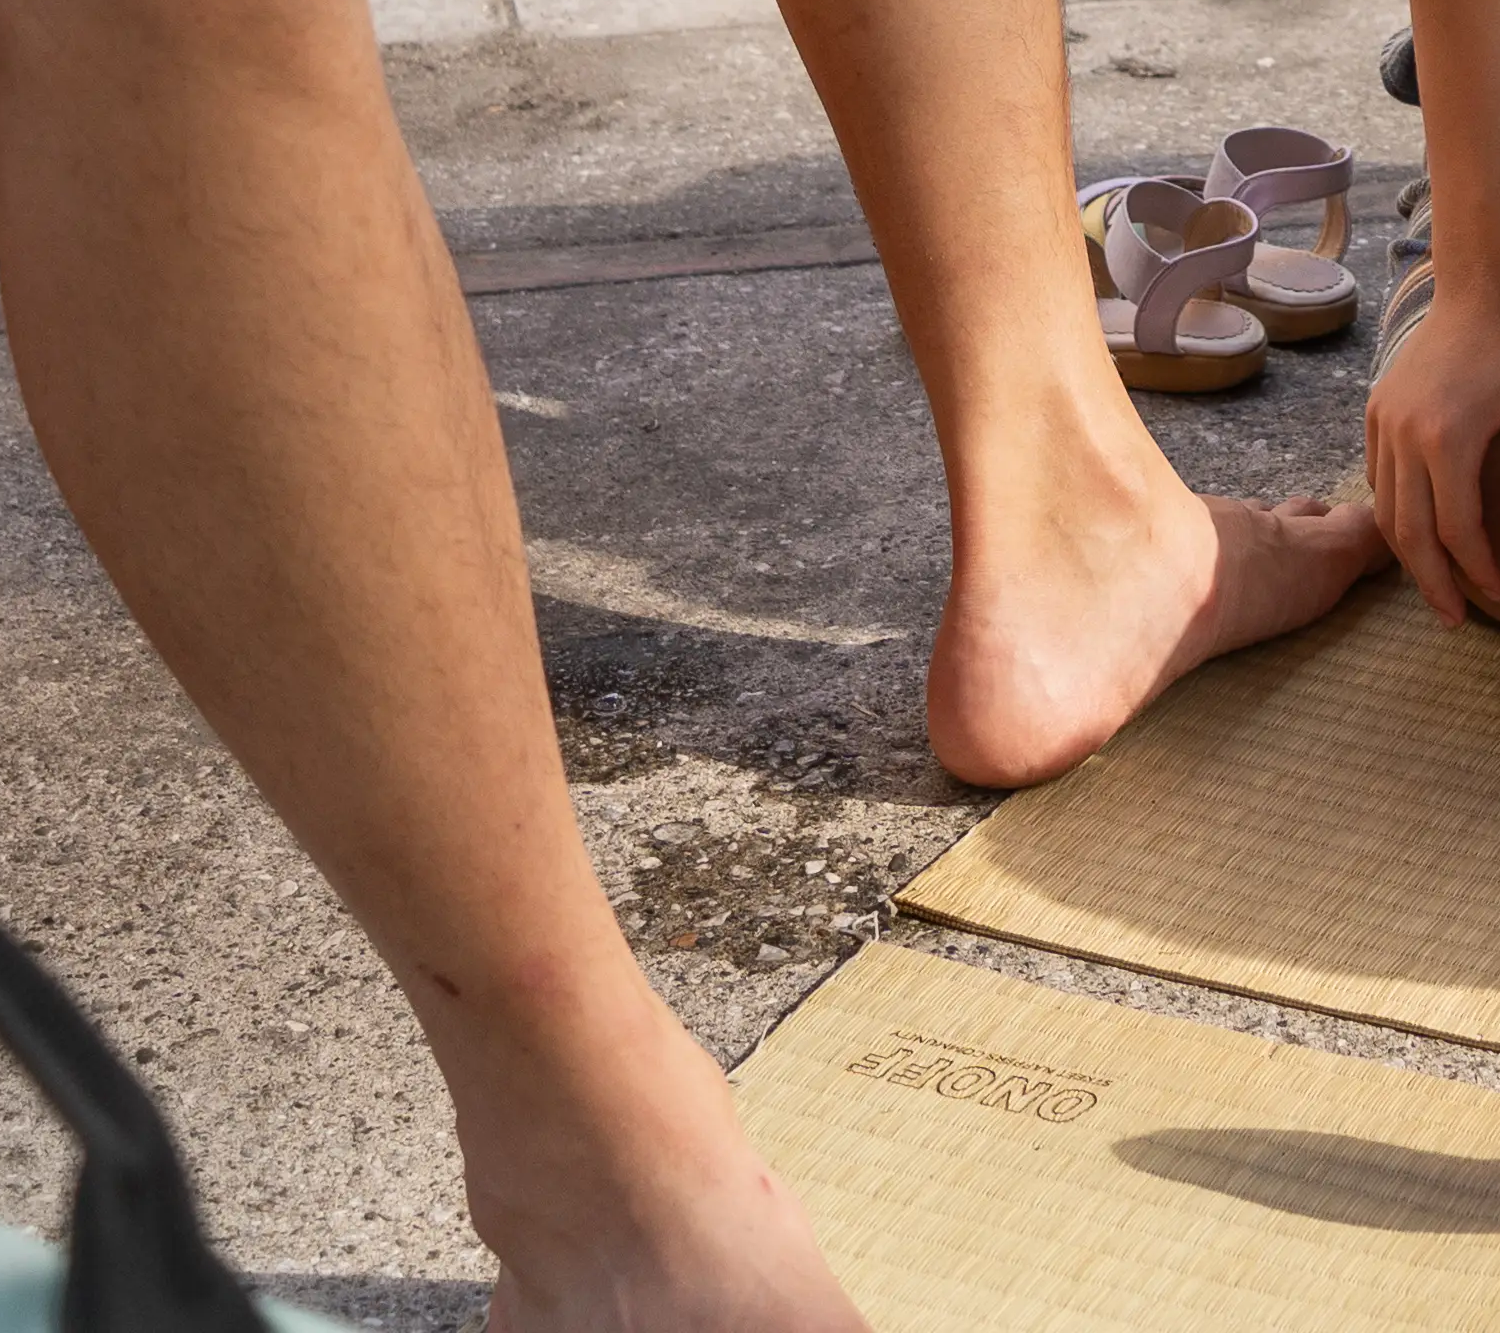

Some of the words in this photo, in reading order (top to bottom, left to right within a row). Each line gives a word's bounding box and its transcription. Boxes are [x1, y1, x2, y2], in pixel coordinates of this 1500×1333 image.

[891, 1030, 986, 1058] COMMUNITY
[986, 1052, 1055, 1074] NAPPERS
[846, 1047, 1098, 1124] ONOFF
[1057, 1071, 1113, 1087] STREET
